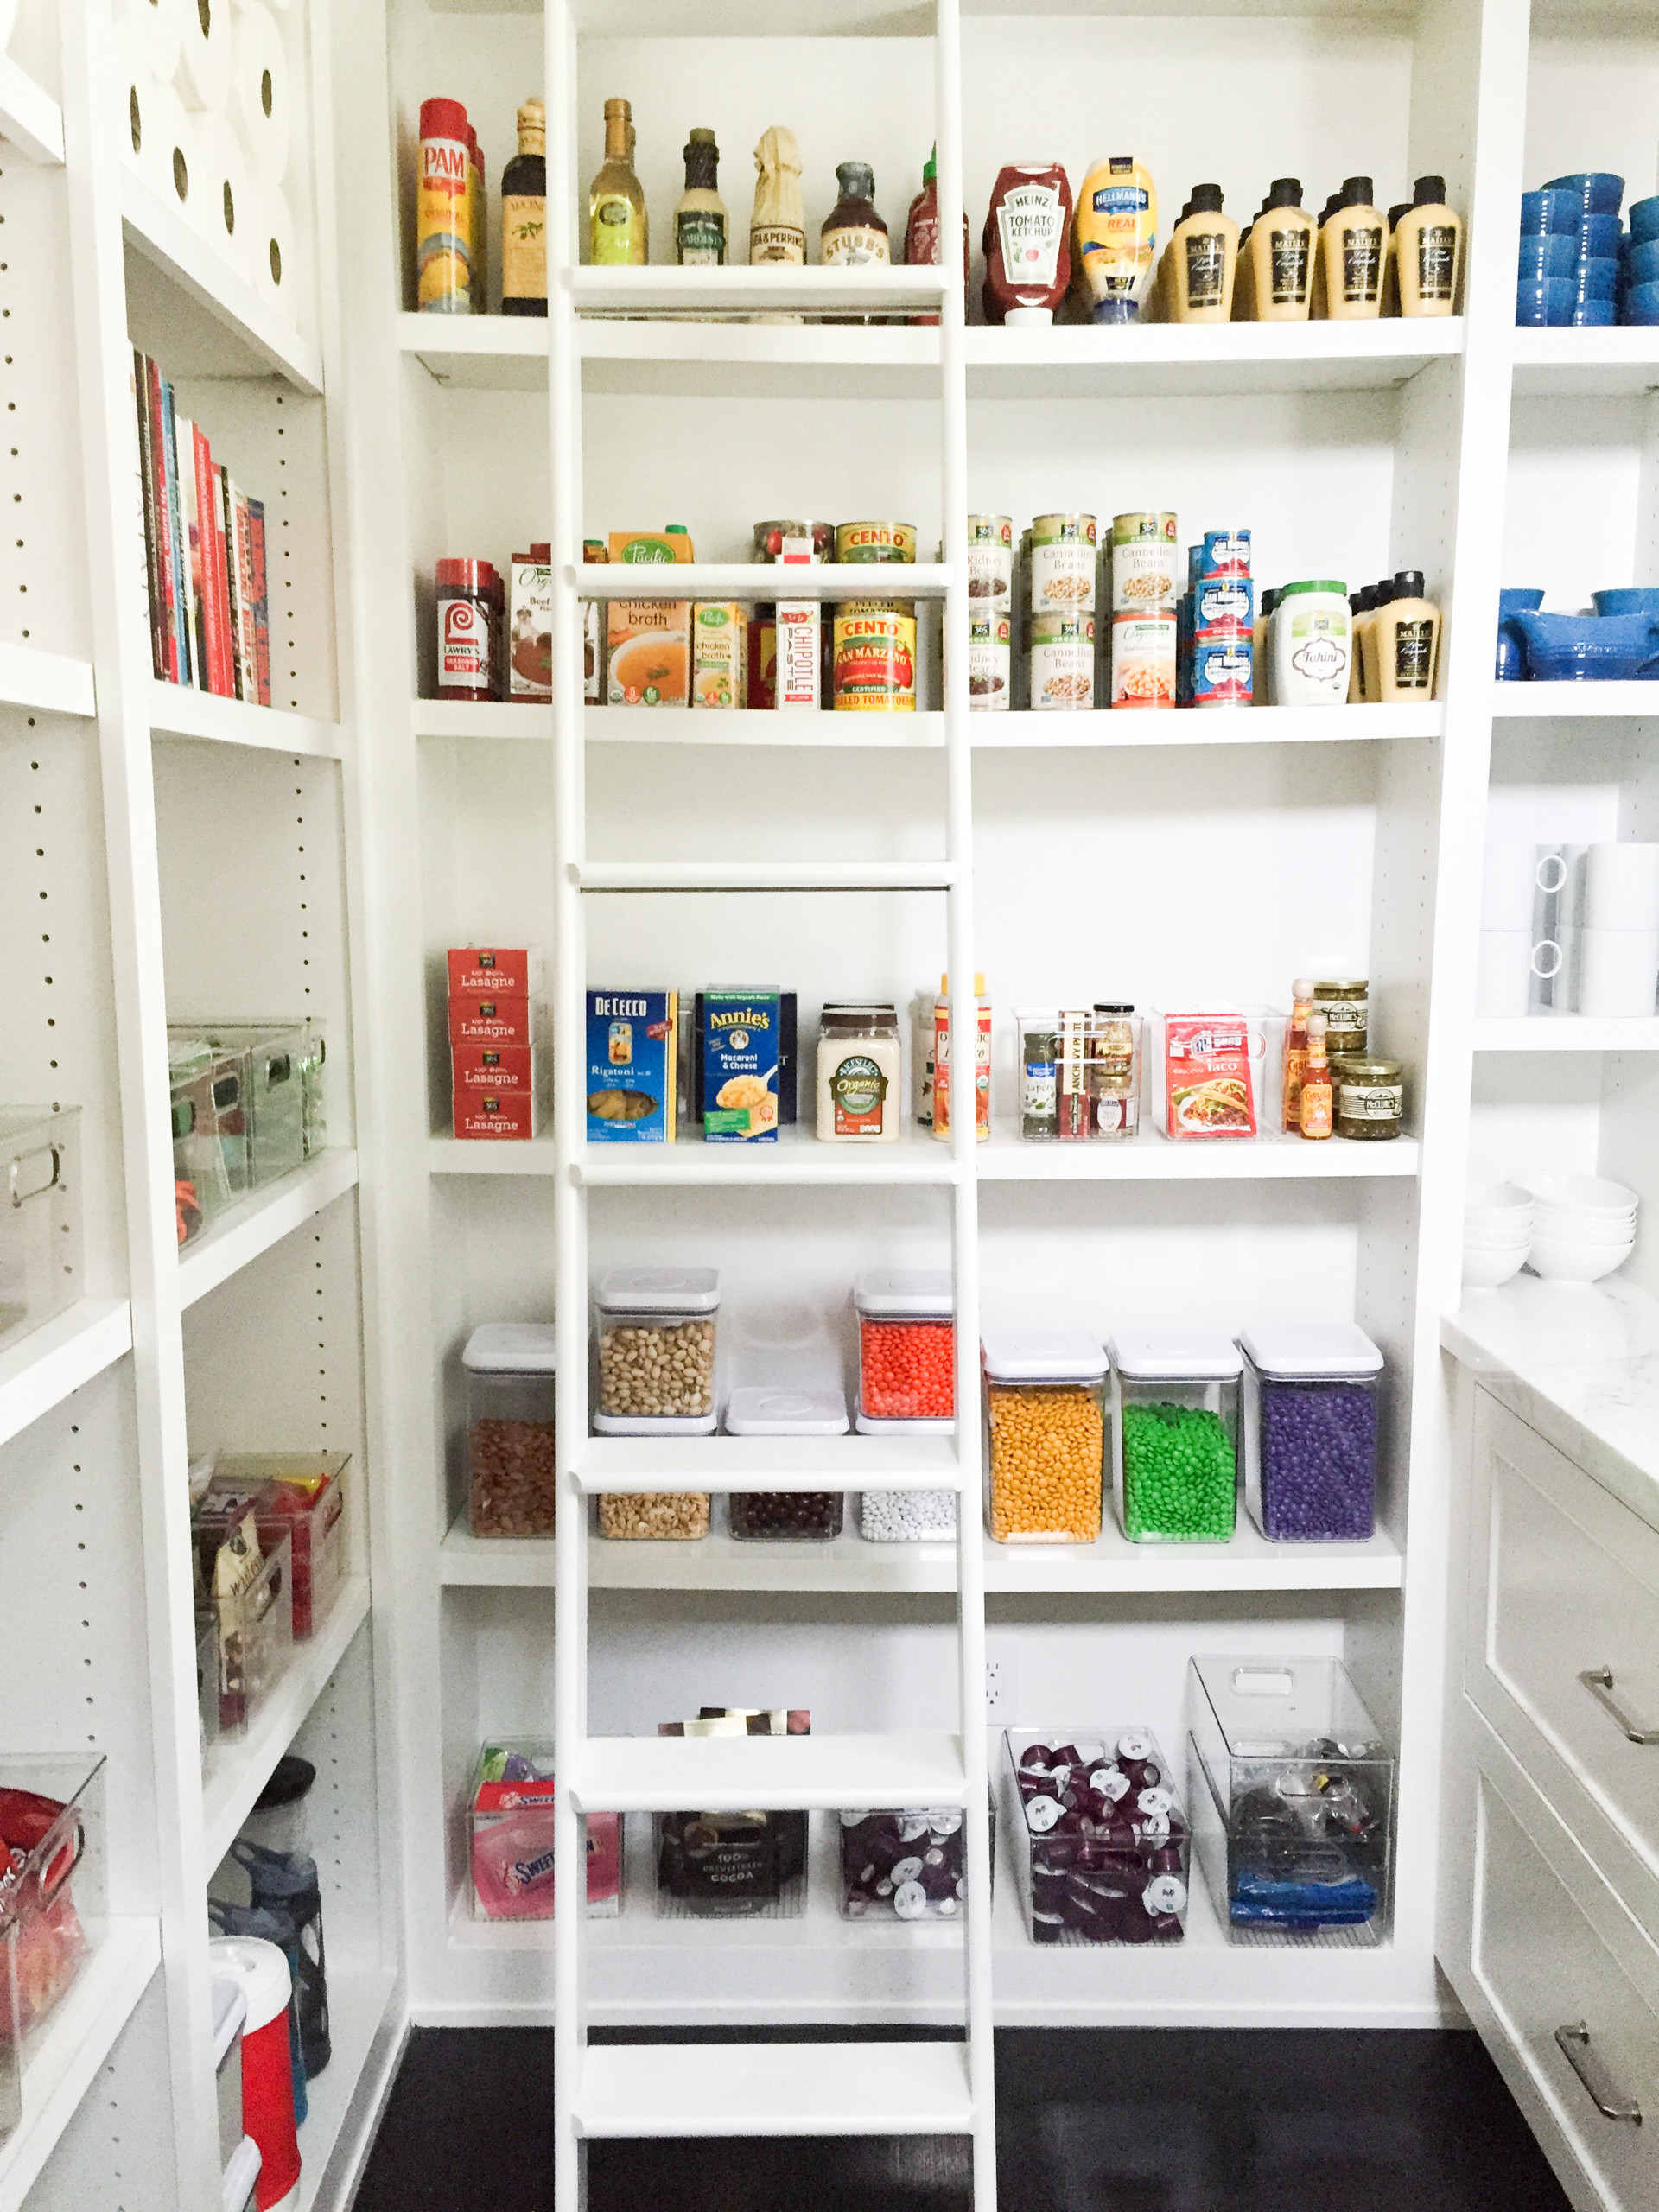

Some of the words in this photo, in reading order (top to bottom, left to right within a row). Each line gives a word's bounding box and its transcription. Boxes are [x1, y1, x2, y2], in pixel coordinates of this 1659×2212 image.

[424, 146, 464, 179] PAM
[1015, 194, 1050, 207] HEINZ
[1096, 189, 1147, 206] HELLMANN'S
[1009, 216, 1054, 228] TOMATO
[1108, 219, 1136, 229] REAL
[1011, 227, 1053, 237] KETCHUP
[826, 235, 885, 259] STUBB'S
[977, 527, 992, 536] 365
[1064, 527, 1078, 536] 365
[1141, 524, 1156, 532] 365
[849, 531, 905, 547] CENTO
[968, 555, 1002, 566] Kidney
[1054, 560, 1085, 570] Beans
[1133, 558, 1165, 569] Beans
[530, 596, 550, 605] Beef
[628, 612, 668, 626] broth
[844, 620, 899, 636] CENTO
[974, 625, 988, 634] 365
[1064, 625, 1078, 634] 365
[444, 646, 480, 655] LAWRY'S
[696, 641, 730, 650] chicken
[794, 626, 813, 691] CHIPOTLE
[855, 647, 907, 665] MARZANO
[969, 653, 1000, 664] idney
[1303, 652, 1338, 664] Tahini
[1054, 658, 1085, 669] Beans
[461, 975, 516, 989] Lasagne
[595, 996, 610, 1016] DE
[612, 998, 647, 1017] CECCO
[710, 1007, 771, 1030] Annie's
[461, 1022, 516, 1038] Lasagne
[591, 1065, 634, 1077] Rigatoni
[1072, 1048, 1081, 1090] ANCHVY
[1207, 1062, 1238, 1072] Taco
[464, 1071, 518, 1086] Lasagne
[836, 1079, 880, 1095] Organic
[1027, 1084, 1053, 1094] capers
[465, 1118, 518, 1133] Lasagne
[710, 1871, 754, 1883] COCOA
